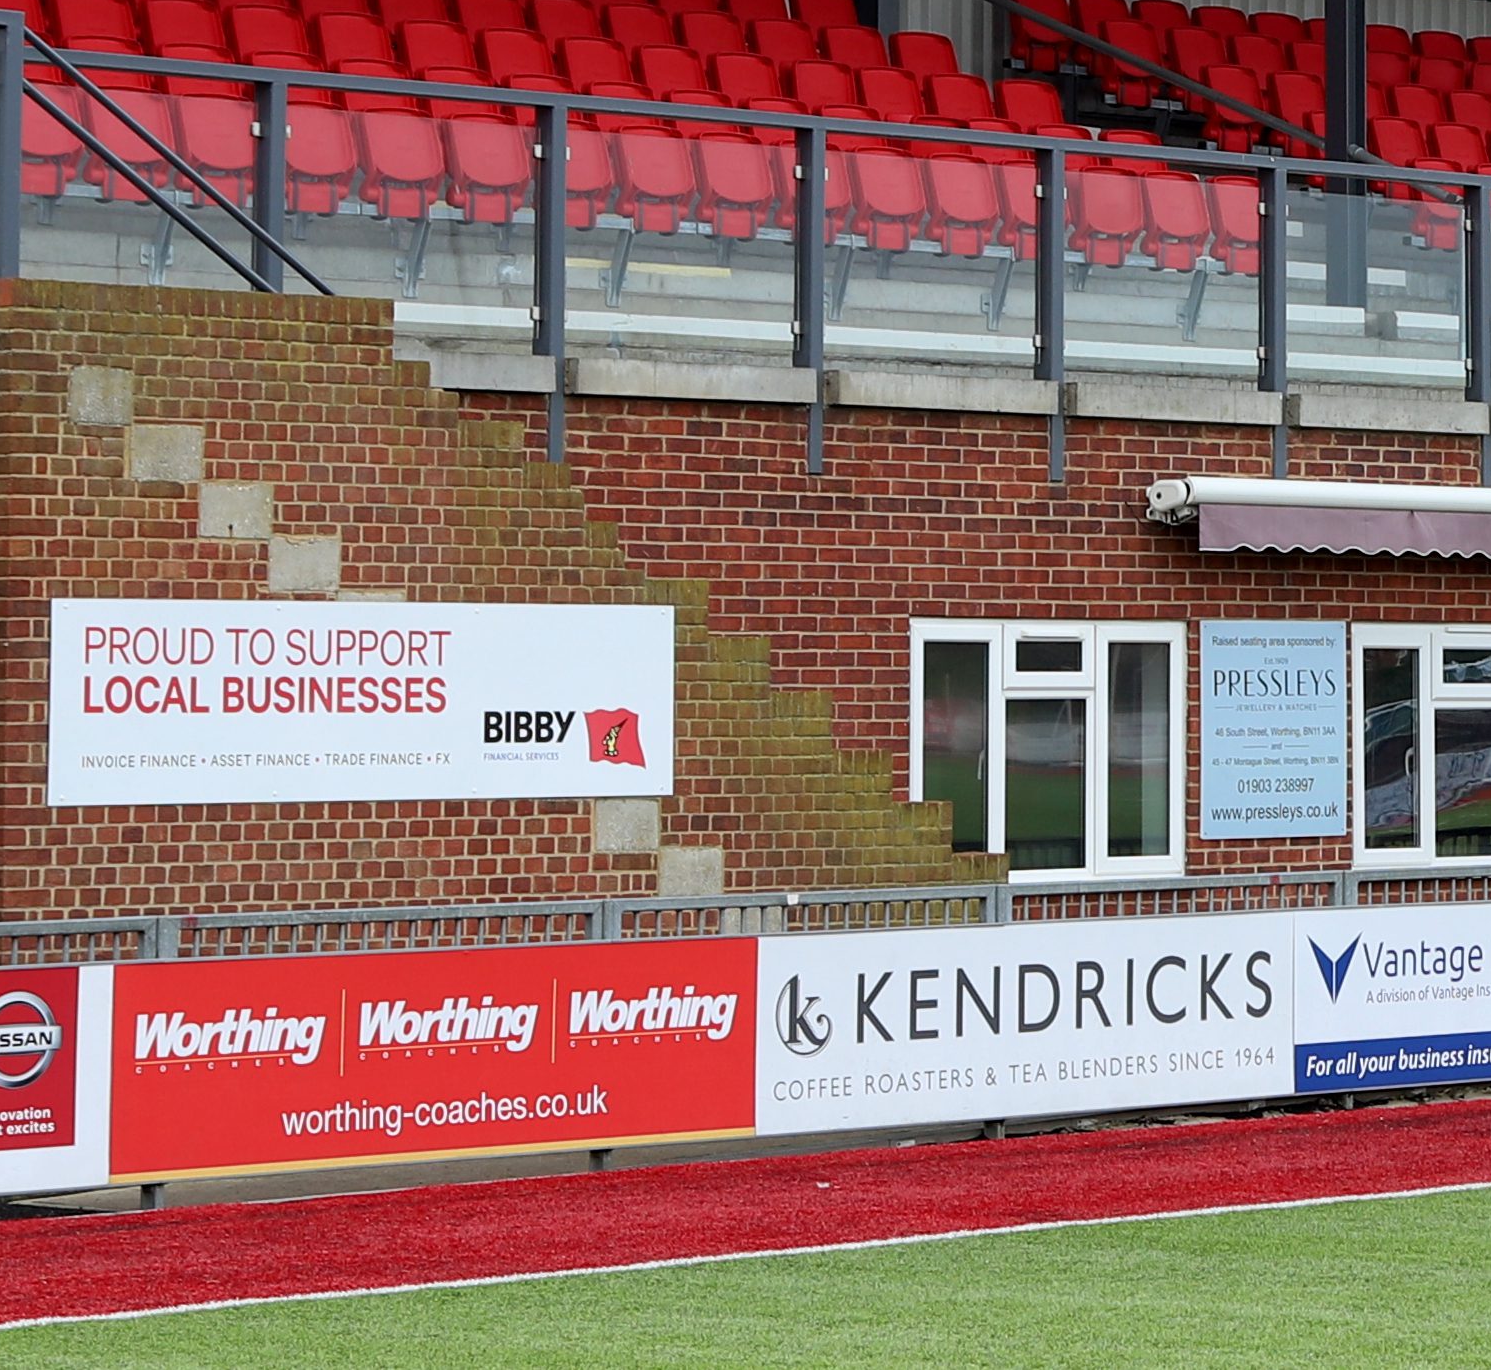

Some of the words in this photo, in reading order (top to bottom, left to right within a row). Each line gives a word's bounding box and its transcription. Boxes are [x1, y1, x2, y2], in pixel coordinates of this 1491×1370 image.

[85, 627, 215, 665] PROUD
[225, 629, 275, 666] TO
[286, 629, 451, 667] SUPPORT
[1212, 636, 1238, 646] Raised
[1241, 637, 1267, 648] seating
[1269, 638, 1285, 646] area
[1287, 637, 1324, 648] sponsored
[83, 676, 210, 714] LOCAL
[222, 677, 447, 713] BUSINESSES
[1214, 670, 1336, 697] PRESSLEYS
[482, 710, 575, 745] BIBBY
[81, 755, 135, 768] INVOICE
[140, 755, 196, 768] FINANCE
[210, 754, 251, 767] ASSET
[257, 753, 310, 766] FINANCE
[325, 753, 365, 766] TRADE
[370, 752, 422, 766] FINANCE
[435, 752, 450, 765] FX
[1238, 779, 1271, 794] 01903
[1275, 778, 1314, 792] 238997
[1212, 802, 1338, 823] www.pressleys.co.uk
[1362, 940, 1483, 982] Vantage
[857, 950, 1274, 1044] KENDRICKS
[1366, 991, 1374, 1003] A
[1376, 987, 1416, 1003] division
[1419, 986, 1430, 1001] of
[1431, 984, 1473, 1001] Vantage
[359, 996, 539, 1052] Worthing
[569, 986, 737, 1040] Worthing
[135, 1007, 327, 1065] Worthing
[774, 1077, 853, 1103] COFFEE
[864, 1069, 975, 1095] ROASTERS
[985, 1067, 997, 1087] &
[1009, 1062, 1048, 1086] TEA
[1058, 1056, 1158, 1081] BLENDERS
[1169, 1050, 1224, 1073] SINCE
[1234, 1046, 1276, 1067] 1964
[1306, 1055, 1333, 1078] For
[1336, 1053, 1357, 1075] all
[1359, 1053, 1395, 1078] your
[1398, 1045, 1464, 1071] business
[7, 1121, 55, 1135] excites
[281, 1084, 608, 1136] worthing-coaches.co.uk
